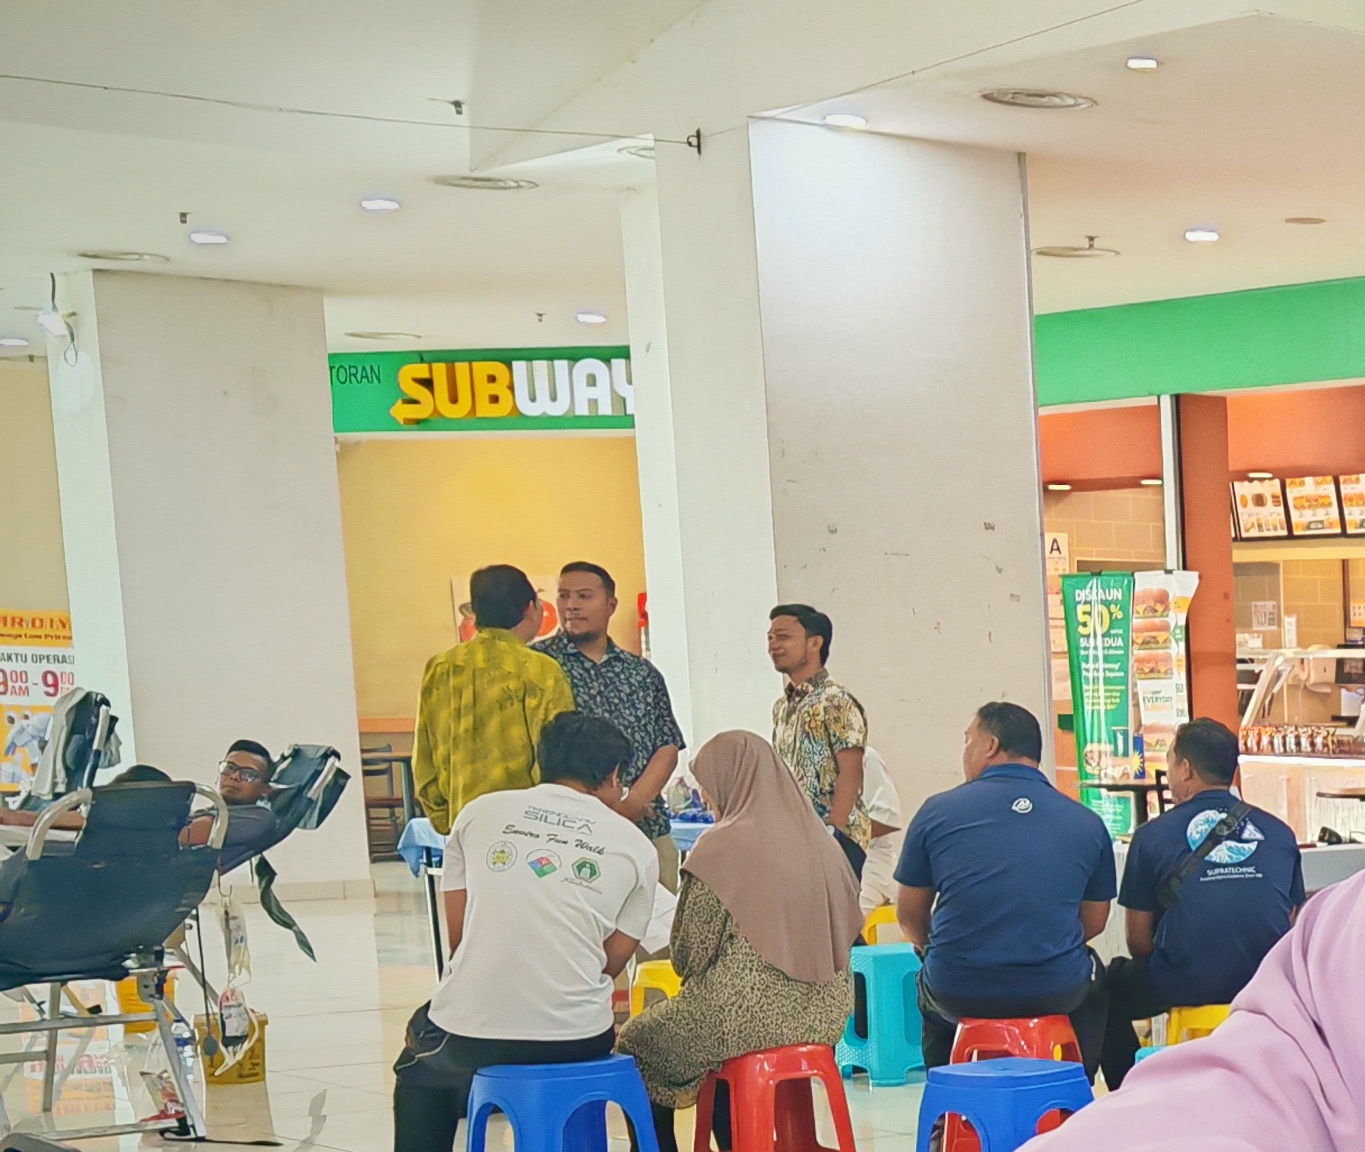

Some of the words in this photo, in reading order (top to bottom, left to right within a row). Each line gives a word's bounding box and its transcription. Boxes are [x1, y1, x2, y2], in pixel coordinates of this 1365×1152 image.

[1050, 538, 1062, 555] A
[42, 670, 59, 697] 9
[523, 810, 593, 836] SILICA
[546, 833, 569, 845] Fun
[574, 838, 605, 856] Walk
